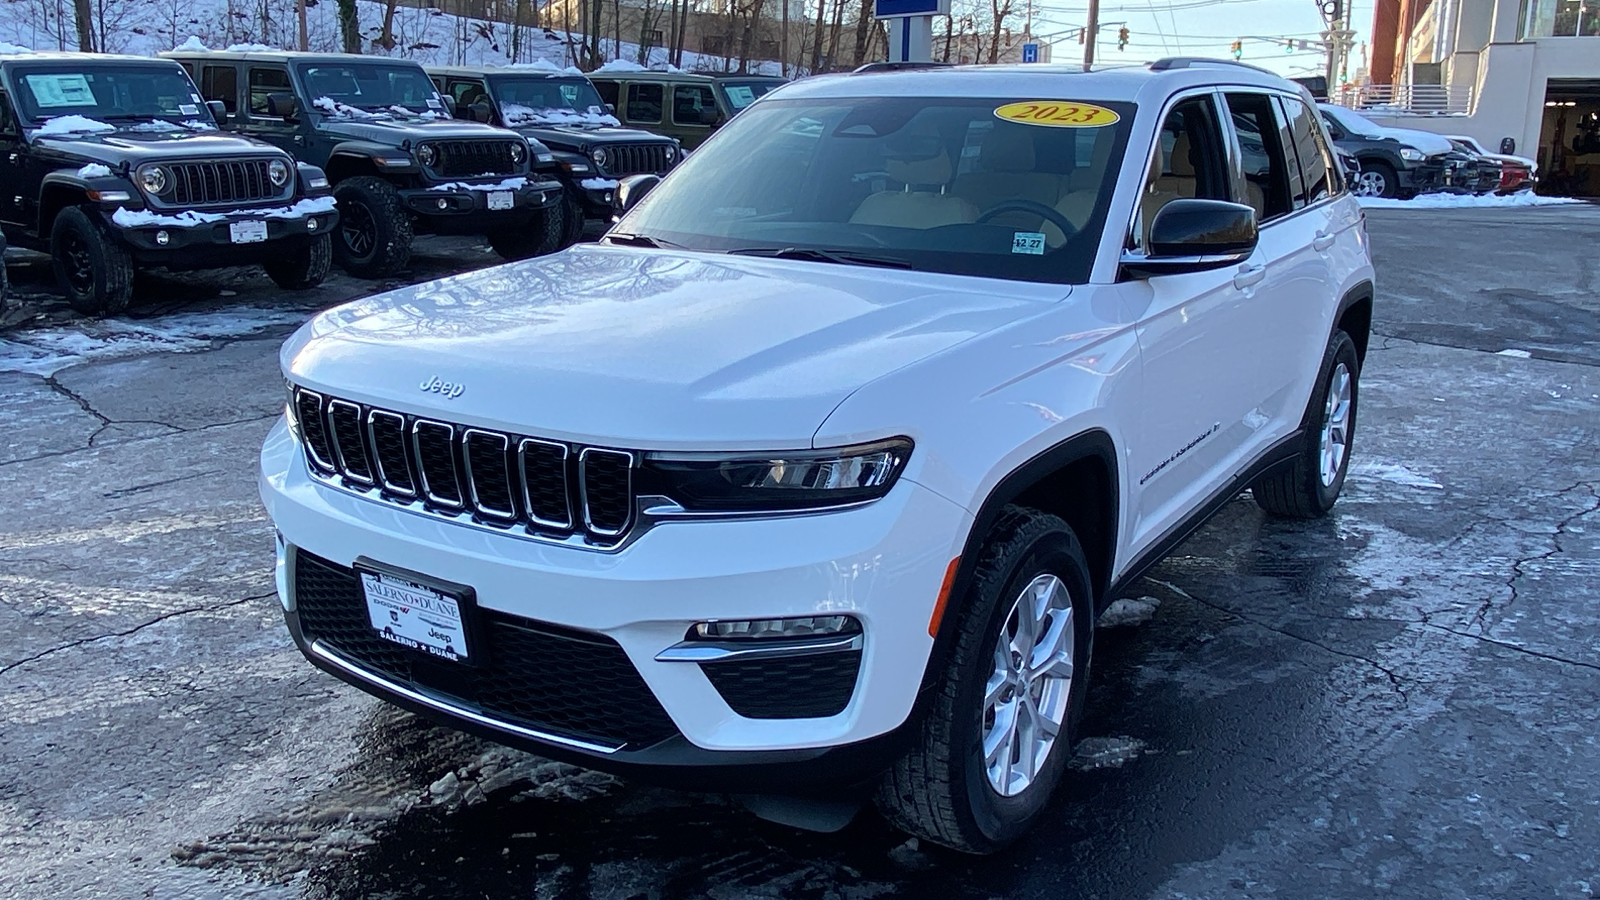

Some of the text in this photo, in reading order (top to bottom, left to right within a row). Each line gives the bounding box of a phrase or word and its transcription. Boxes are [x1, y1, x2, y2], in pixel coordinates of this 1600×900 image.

[1025, 49, 1035, 62] H
[1010, 105, 1100, 123] 2023
[1029, 239, 1041, 249] 27
[419, 374, 466, 400] Jeep
[366, 582, 414, 604] SALERNO
[419, 597, 459, 618] DUANE
[428, 628, 452, 643] Jeep
[380, 631, 459, 662] SALERNO DUANE
